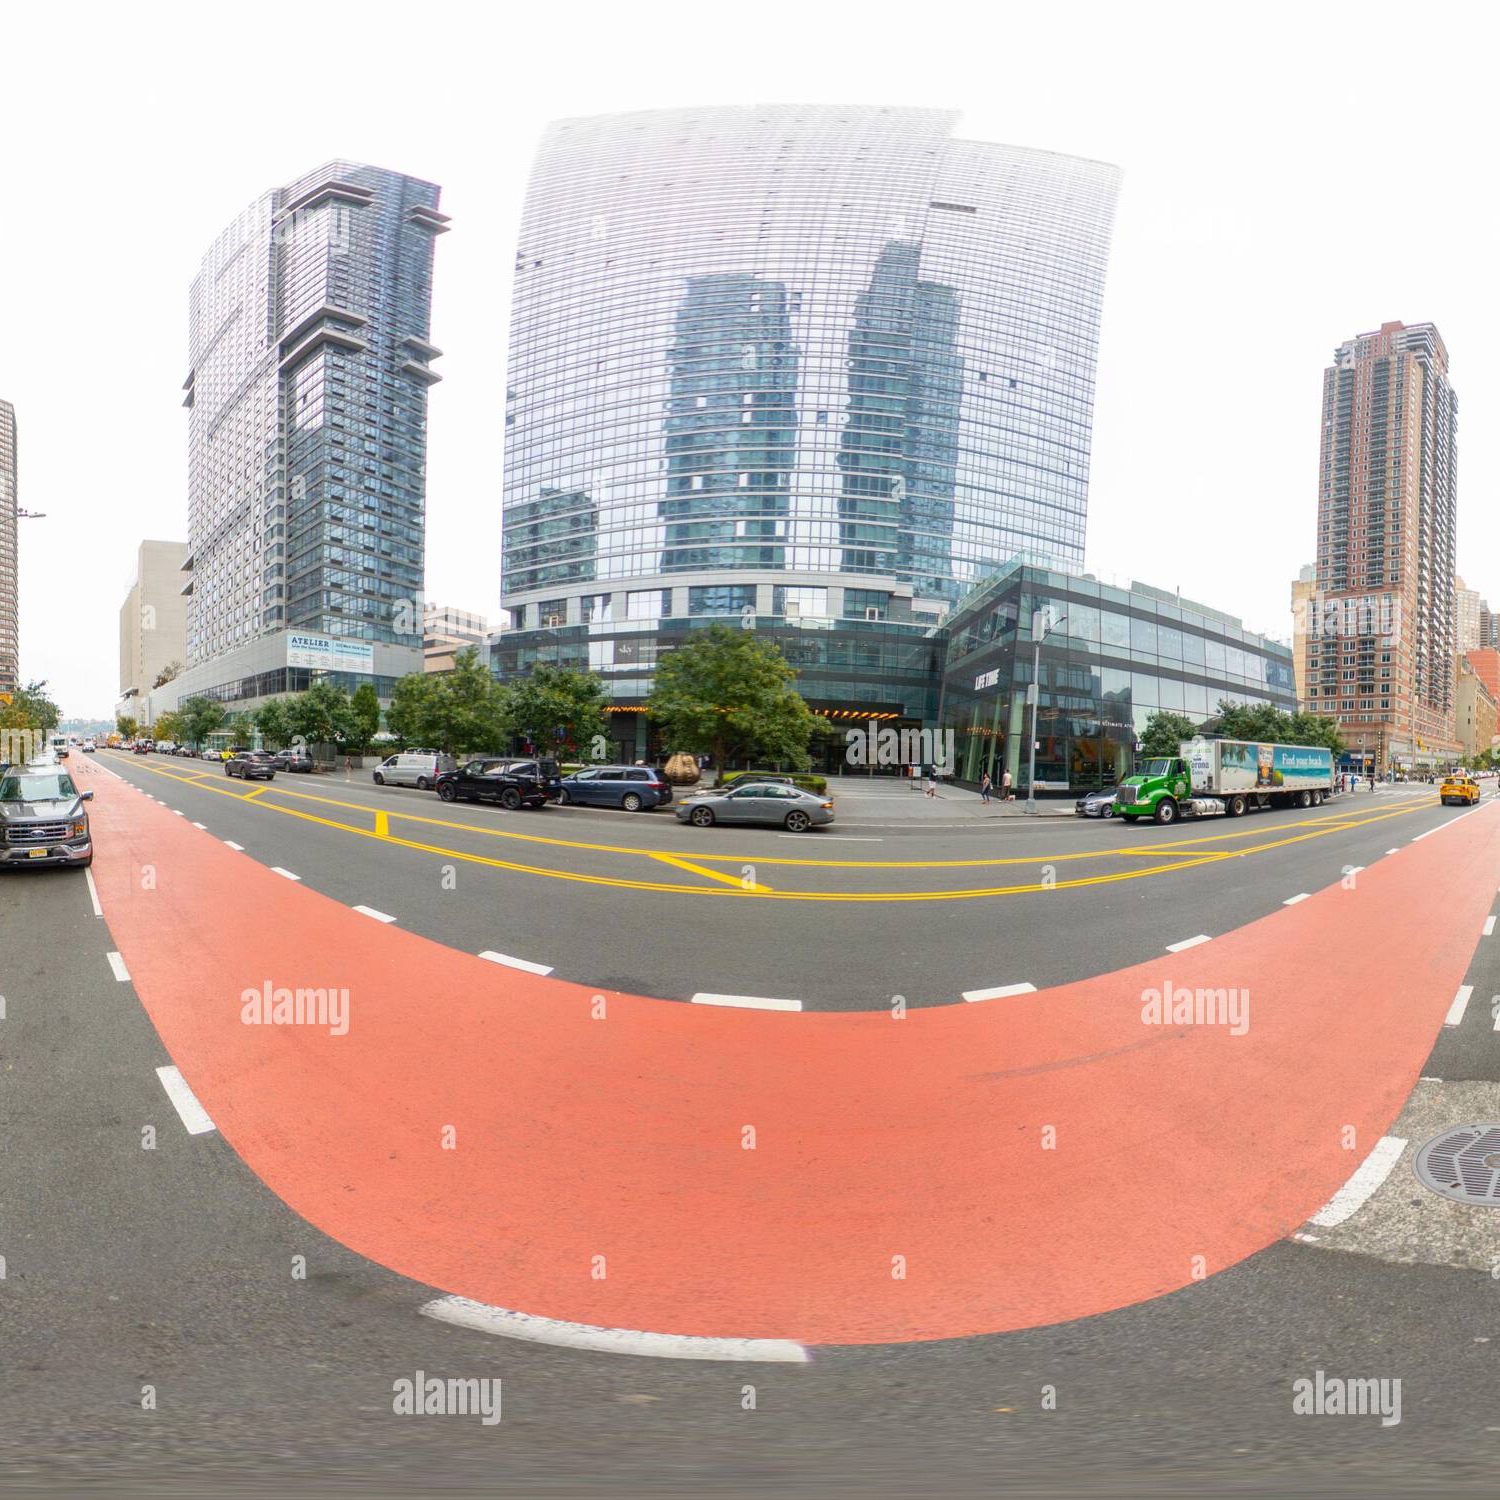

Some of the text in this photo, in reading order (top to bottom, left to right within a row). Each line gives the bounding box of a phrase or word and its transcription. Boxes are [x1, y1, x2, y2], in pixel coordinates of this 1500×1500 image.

[292, 637, 329, 647] ATELIER
[974, 674, 986, 691] LIFE
[1190, 760, 1210, 769] orona
[1281, 753, 1296, 765] Find
[1296, 758, 1309, 767] your
[1309, 755, 1322, 766] beach
